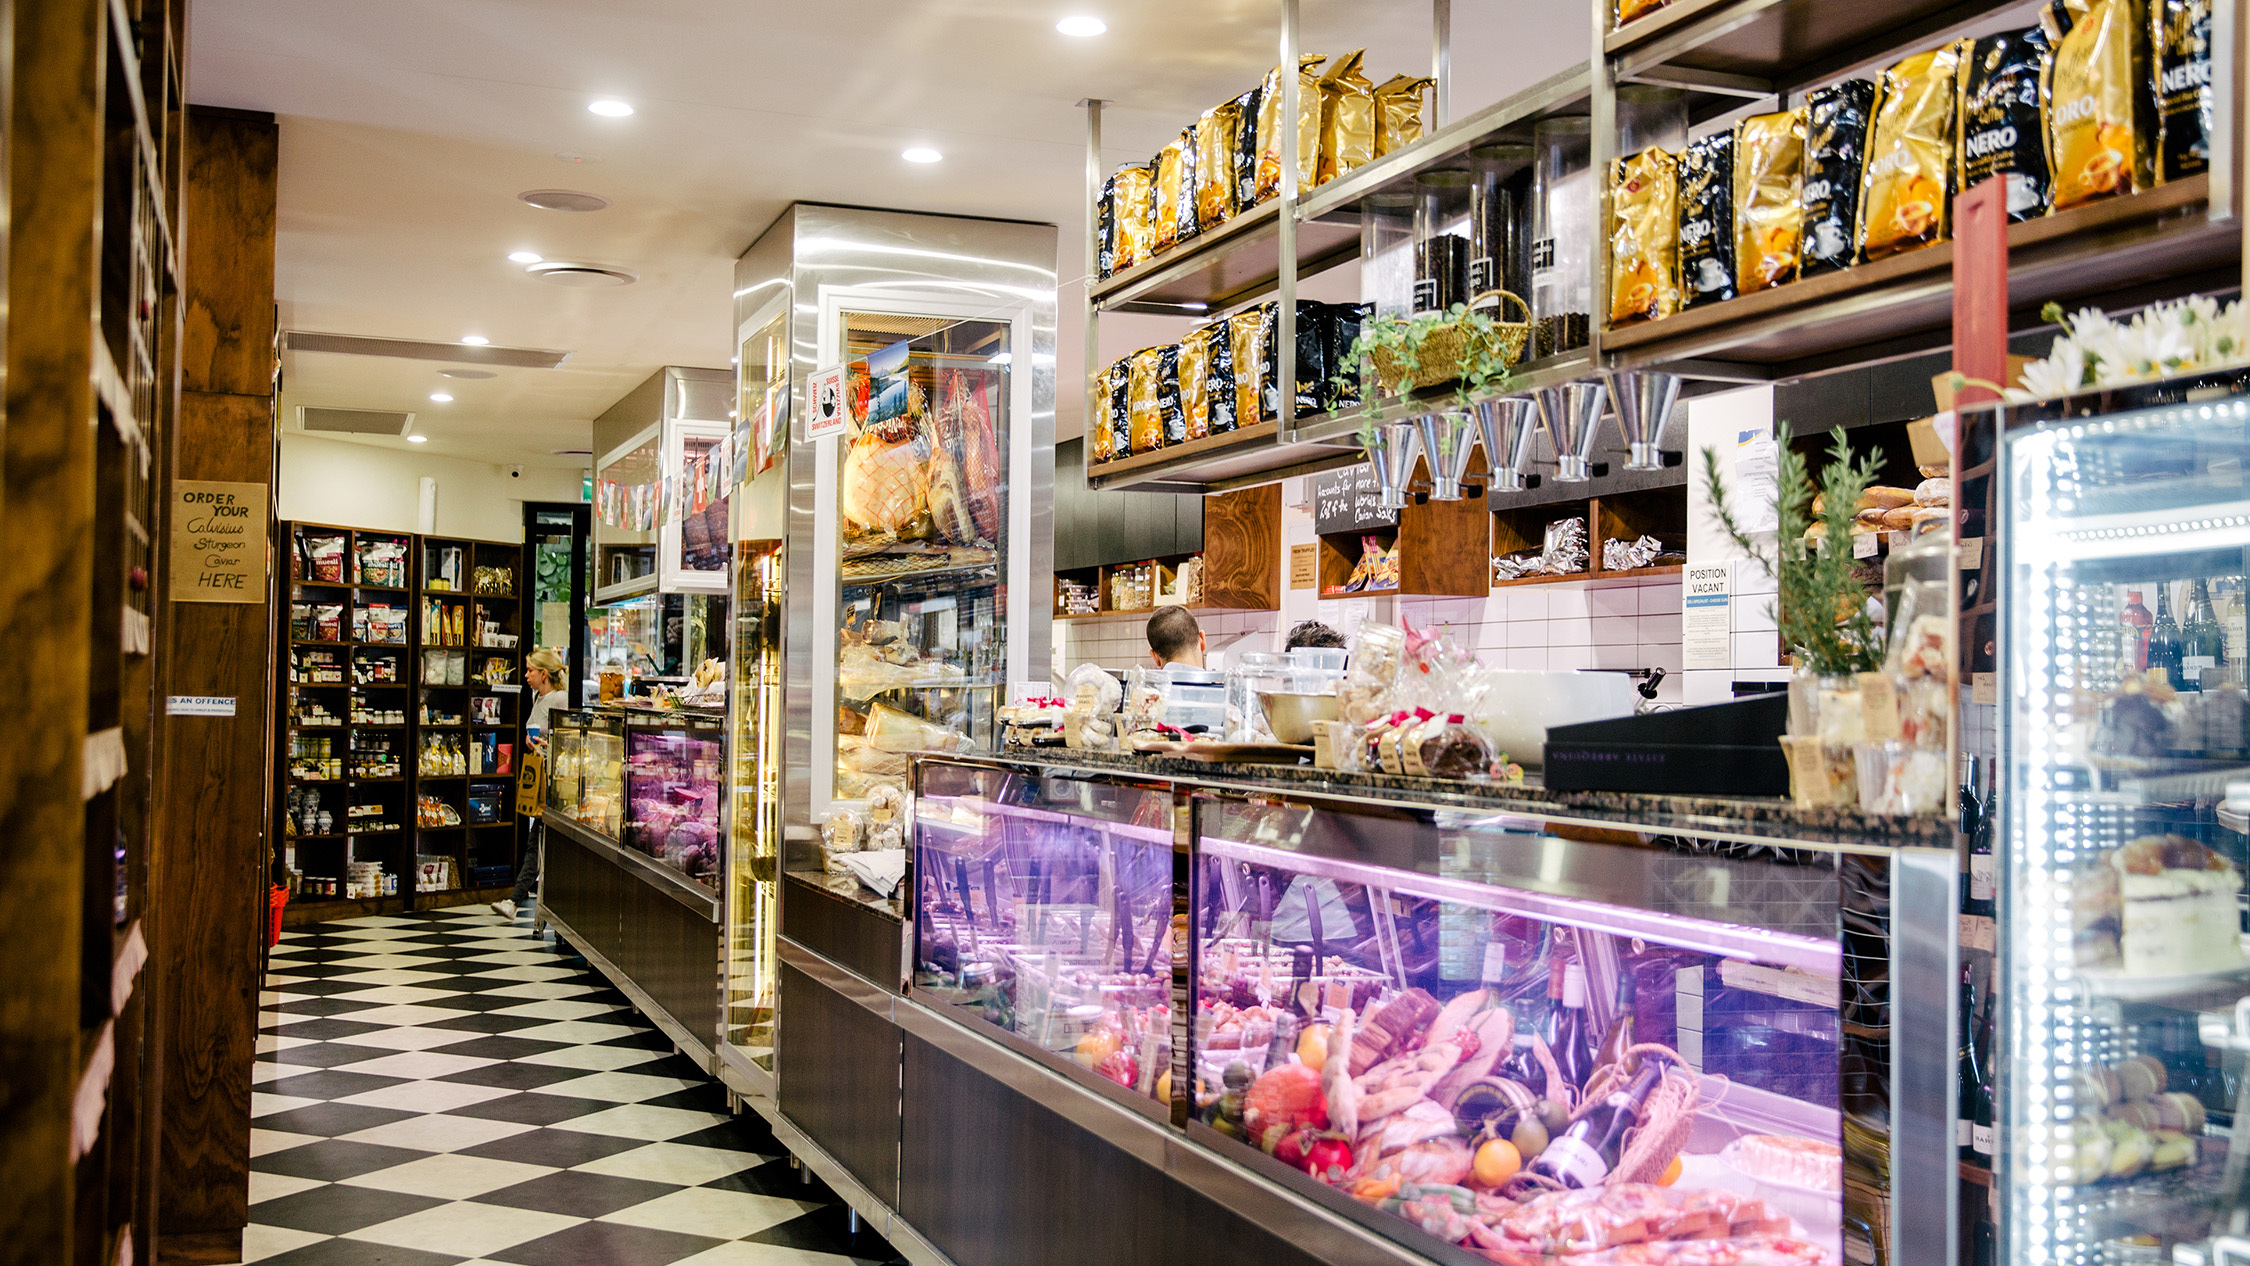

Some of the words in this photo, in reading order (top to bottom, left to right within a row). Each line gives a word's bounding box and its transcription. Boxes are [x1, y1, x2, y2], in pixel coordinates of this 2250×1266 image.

[2056, 94, 2096, 126] ORO
[1965, 126, 2018, 158] NERO
[1875, 149, 1910, 175] ORO
[1680, 219, 1711, 243] NERO
[826, 374, 839, 385] SUISSE
[811, 417, 842, 431] SWITZERLAND
[183, 492, 236, 505] ORDER
[212, 505, 249, 518] YOUR
[187, 517, 244, 534] Calvisius
[193, 538, 246, 552] Sturgeon
[204, 554, 241, 568] Caviar
[198, 572, 248, 589] HERE
[1690, 568, 1727, 580] POSITION
[1692, 582, 1724, 593] VACANT
